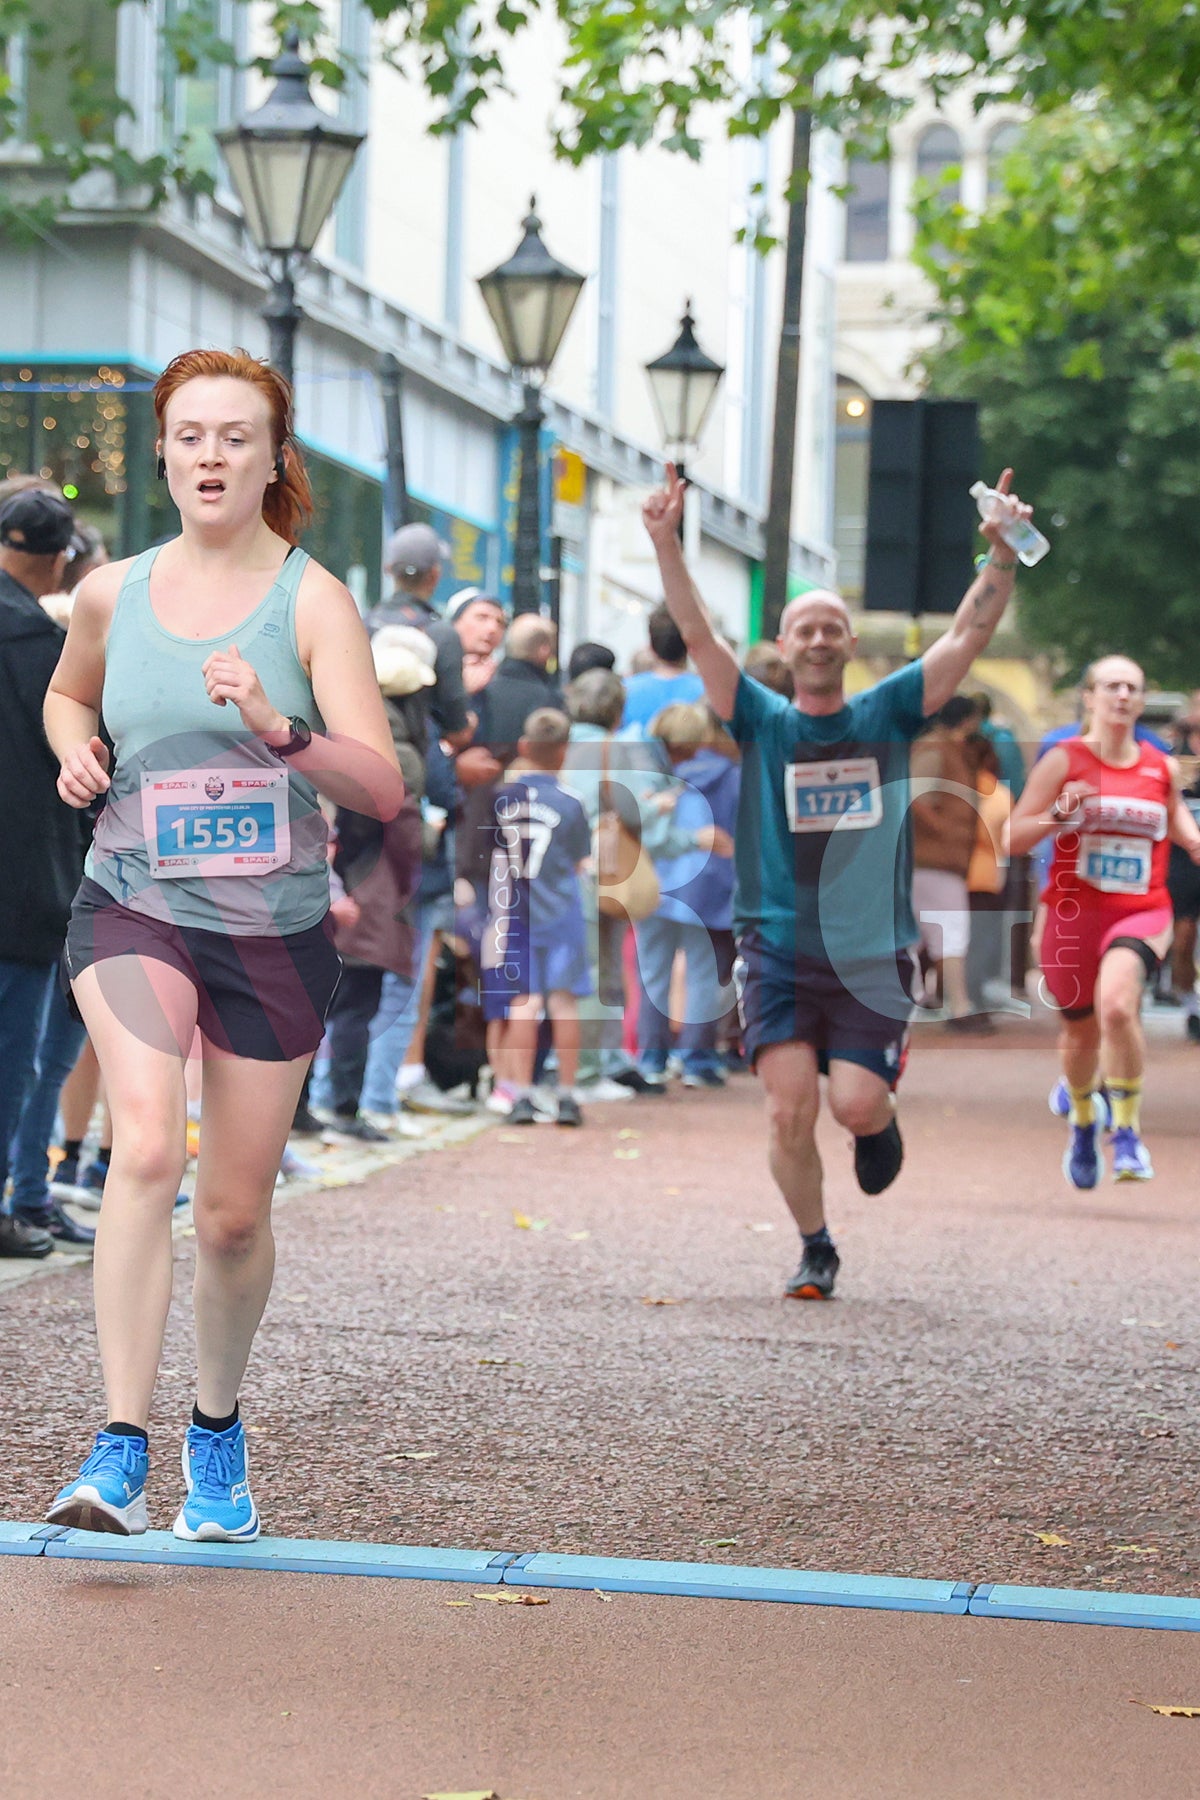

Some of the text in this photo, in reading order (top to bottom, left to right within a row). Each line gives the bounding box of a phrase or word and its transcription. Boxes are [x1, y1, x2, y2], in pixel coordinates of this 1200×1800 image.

[240, 780, 268, 788] SPAR
[805, 789, 863, 814] 1773
[171, 817, 259, 849] 1559
[164, 859, 190, 867] SPAR
